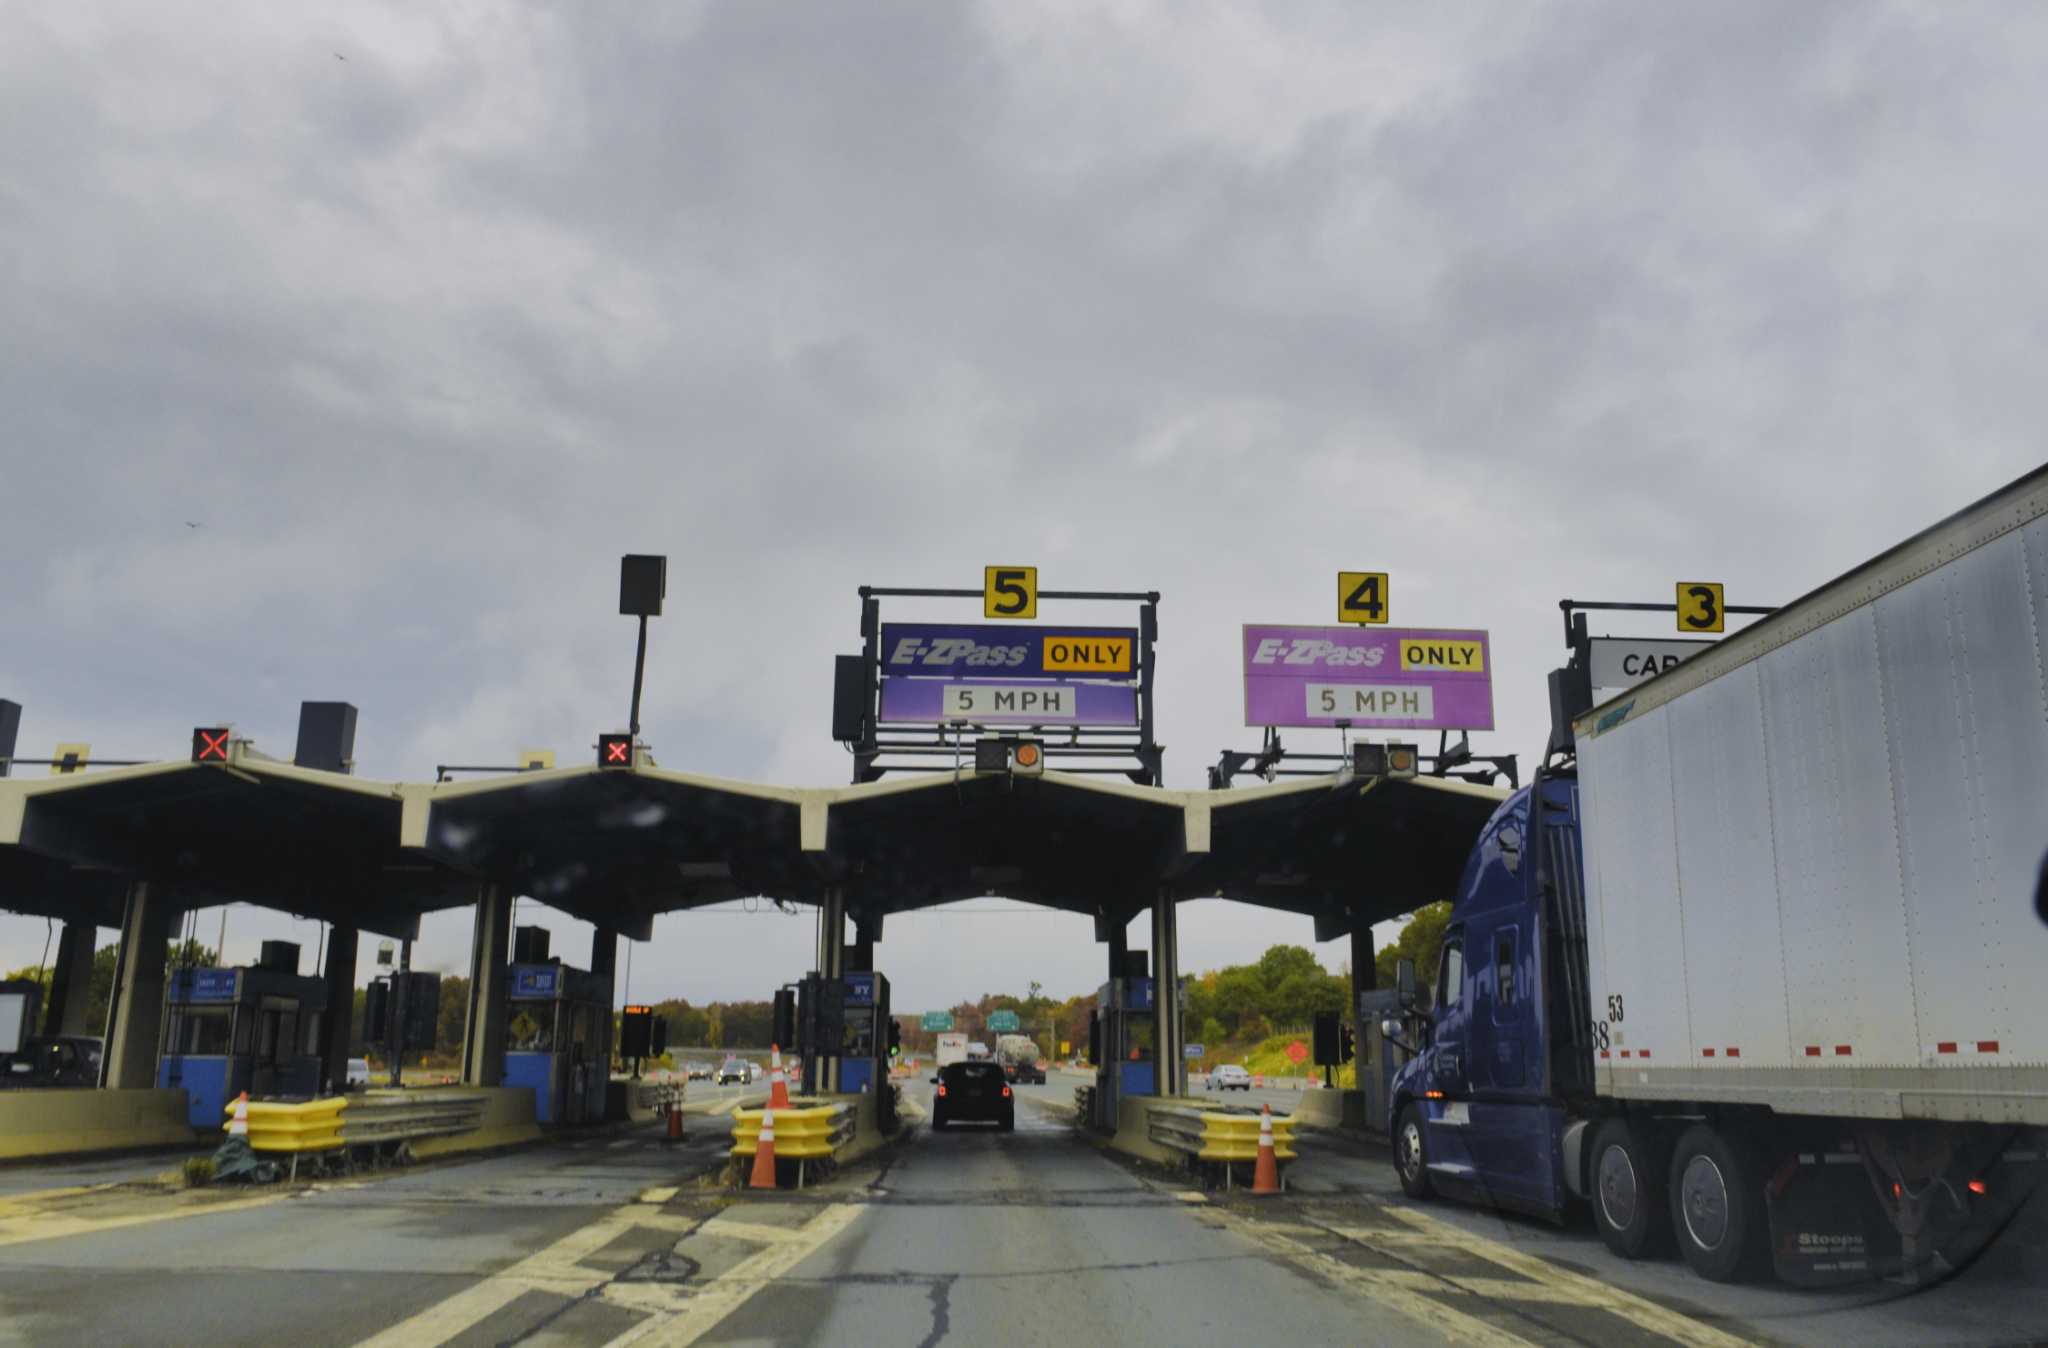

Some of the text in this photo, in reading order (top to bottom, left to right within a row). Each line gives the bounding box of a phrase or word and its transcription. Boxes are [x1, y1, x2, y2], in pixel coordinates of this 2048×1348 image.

[993, 570, 1029, 615] 5
[1343, 575, 1384, 620] 4
[1686, 586, 1718, 629] 3
[889, 637, 1123, 667] E-ZPass ONLY
[1251, 637, 1476, 668] E-ZPass ONLY
[958, 690, 1061, 712] 5 MPH
[1320, 689, 1419, 713] 5 MPH
[1607, 993, 1625, 1023] 53
